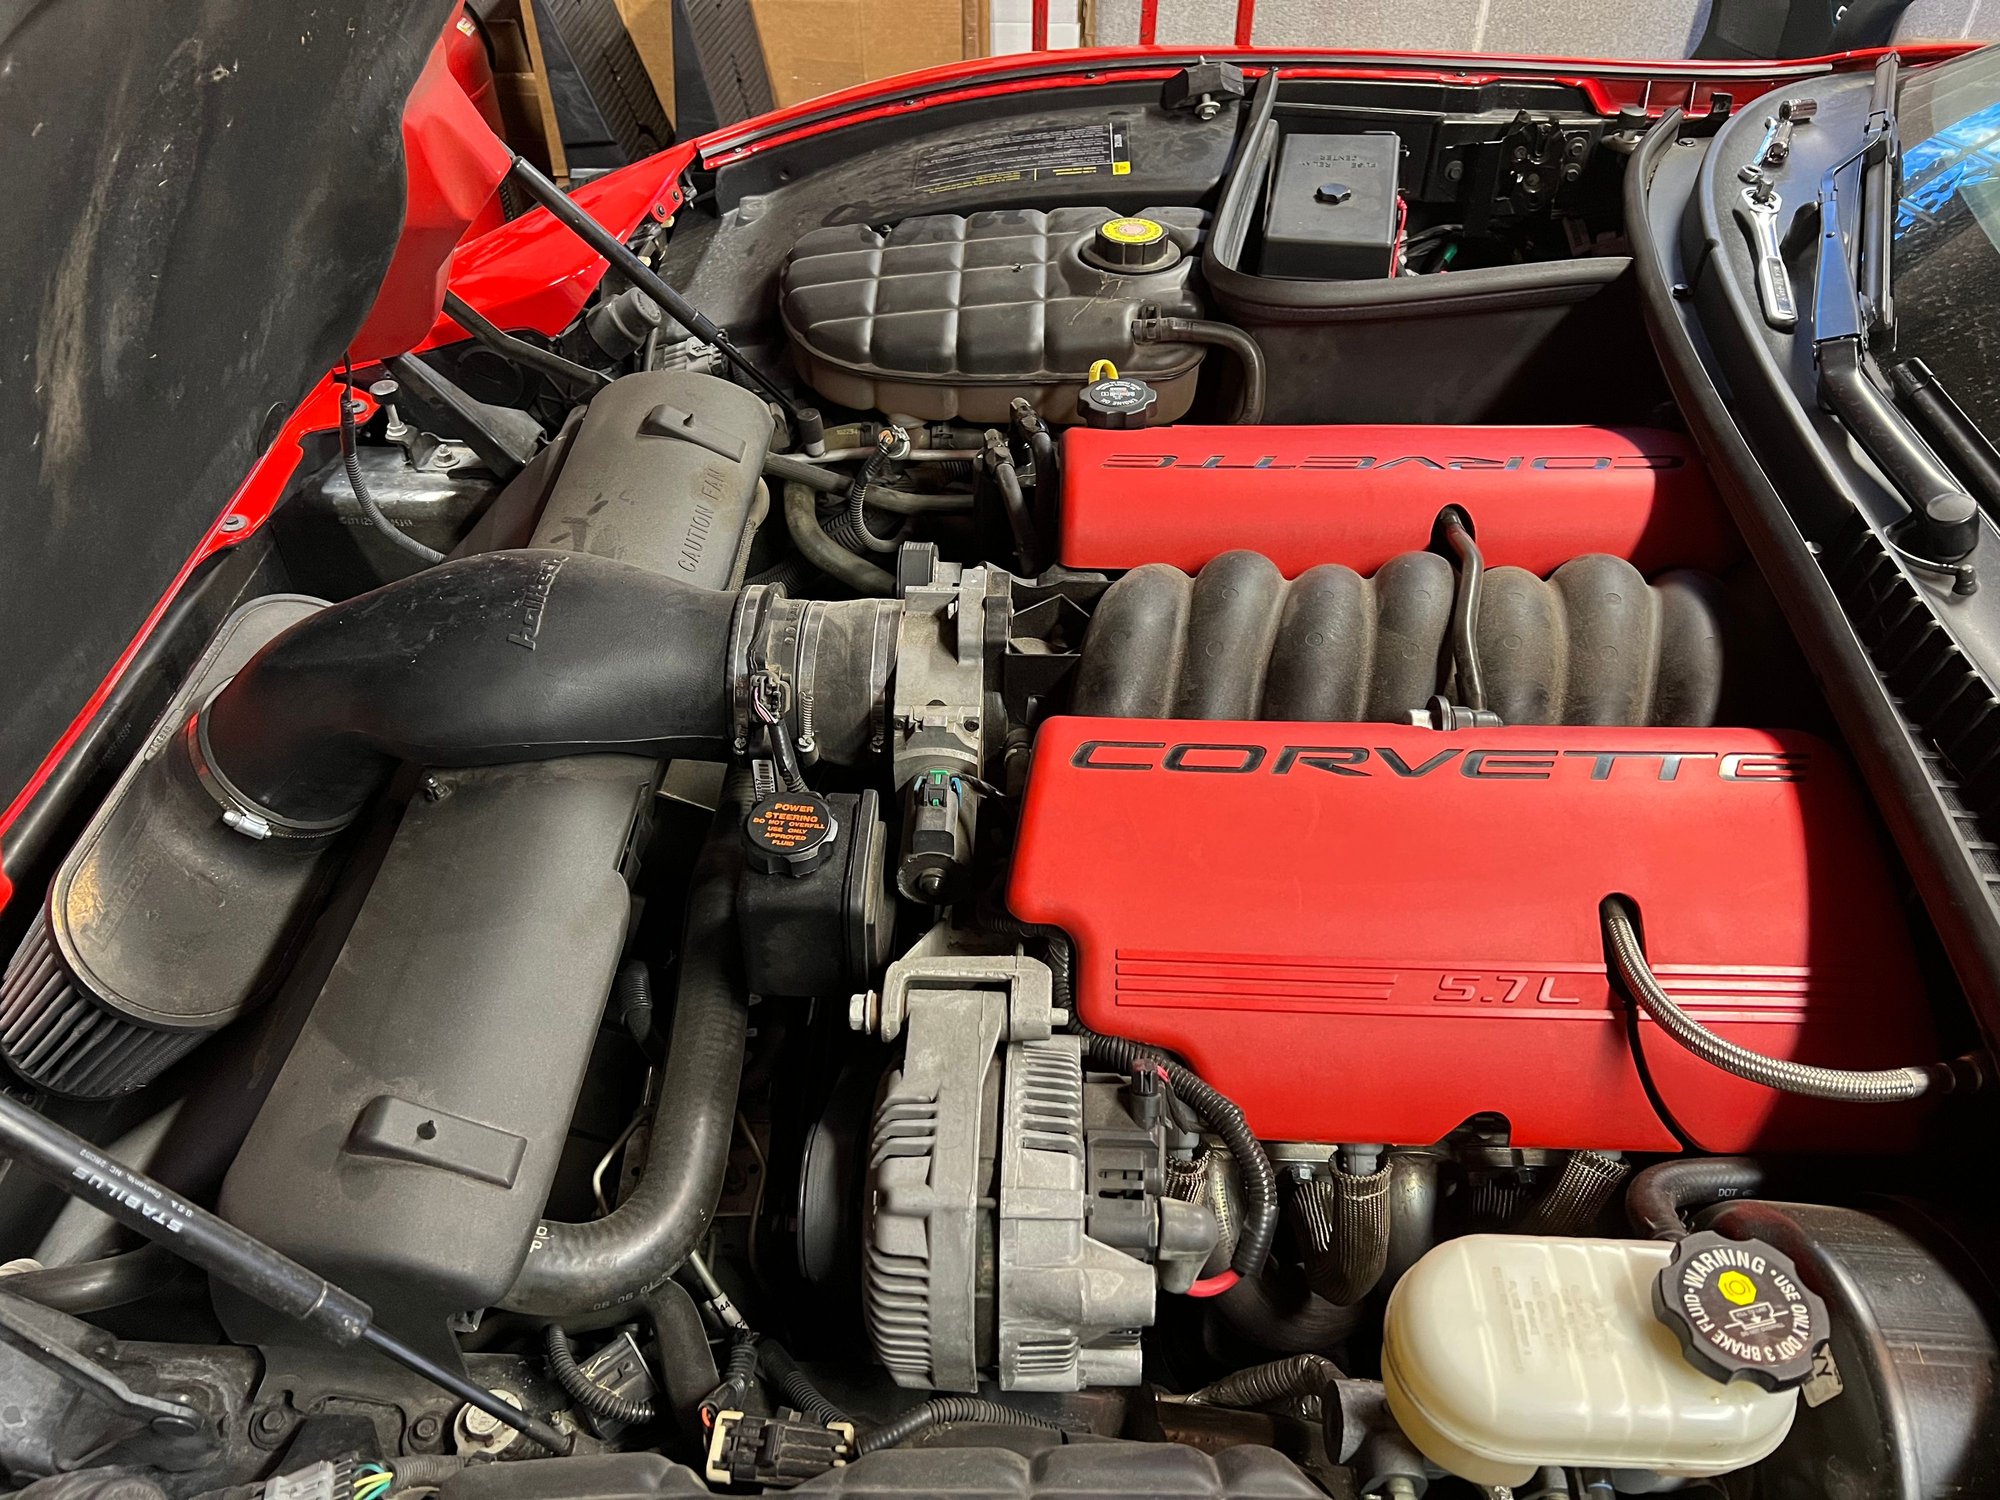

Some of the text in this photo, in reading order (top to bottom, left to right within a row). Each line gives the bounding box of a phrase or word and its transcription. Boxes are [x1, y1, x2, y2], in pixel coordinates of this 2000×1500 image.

[1101, 454, 1685, 470] CORVETTE
[677, 467, 726, 573] CAUTION FAN
[1069, 740, 1813, 783] CORVETTE
[765, 811, 819, 823] STEERING
[774, 803, 815, 813] POWER
[764, 832, 807, 841] APPROVED
[788, 821, 826, 829] OVERFILL
[771, 839, 795, 847] FLUID
[1433, 974, 1581, 1005] 5.7L
[72, 1166, 183, 1233] STABILUS
[1682, 1248, 1767, 1290] WARNING
[1773, 1273, 1802, 1302] USE
[1683, 1293, 1715, 1334] FLUID
[1790, 1304, 1810, 1341] ONLY
[1711, 1329, 1762, 1362] BRAKE
[1763, 1346, 1777, 1362] 3
[1775, 1339, 1803, 1360] DOT
